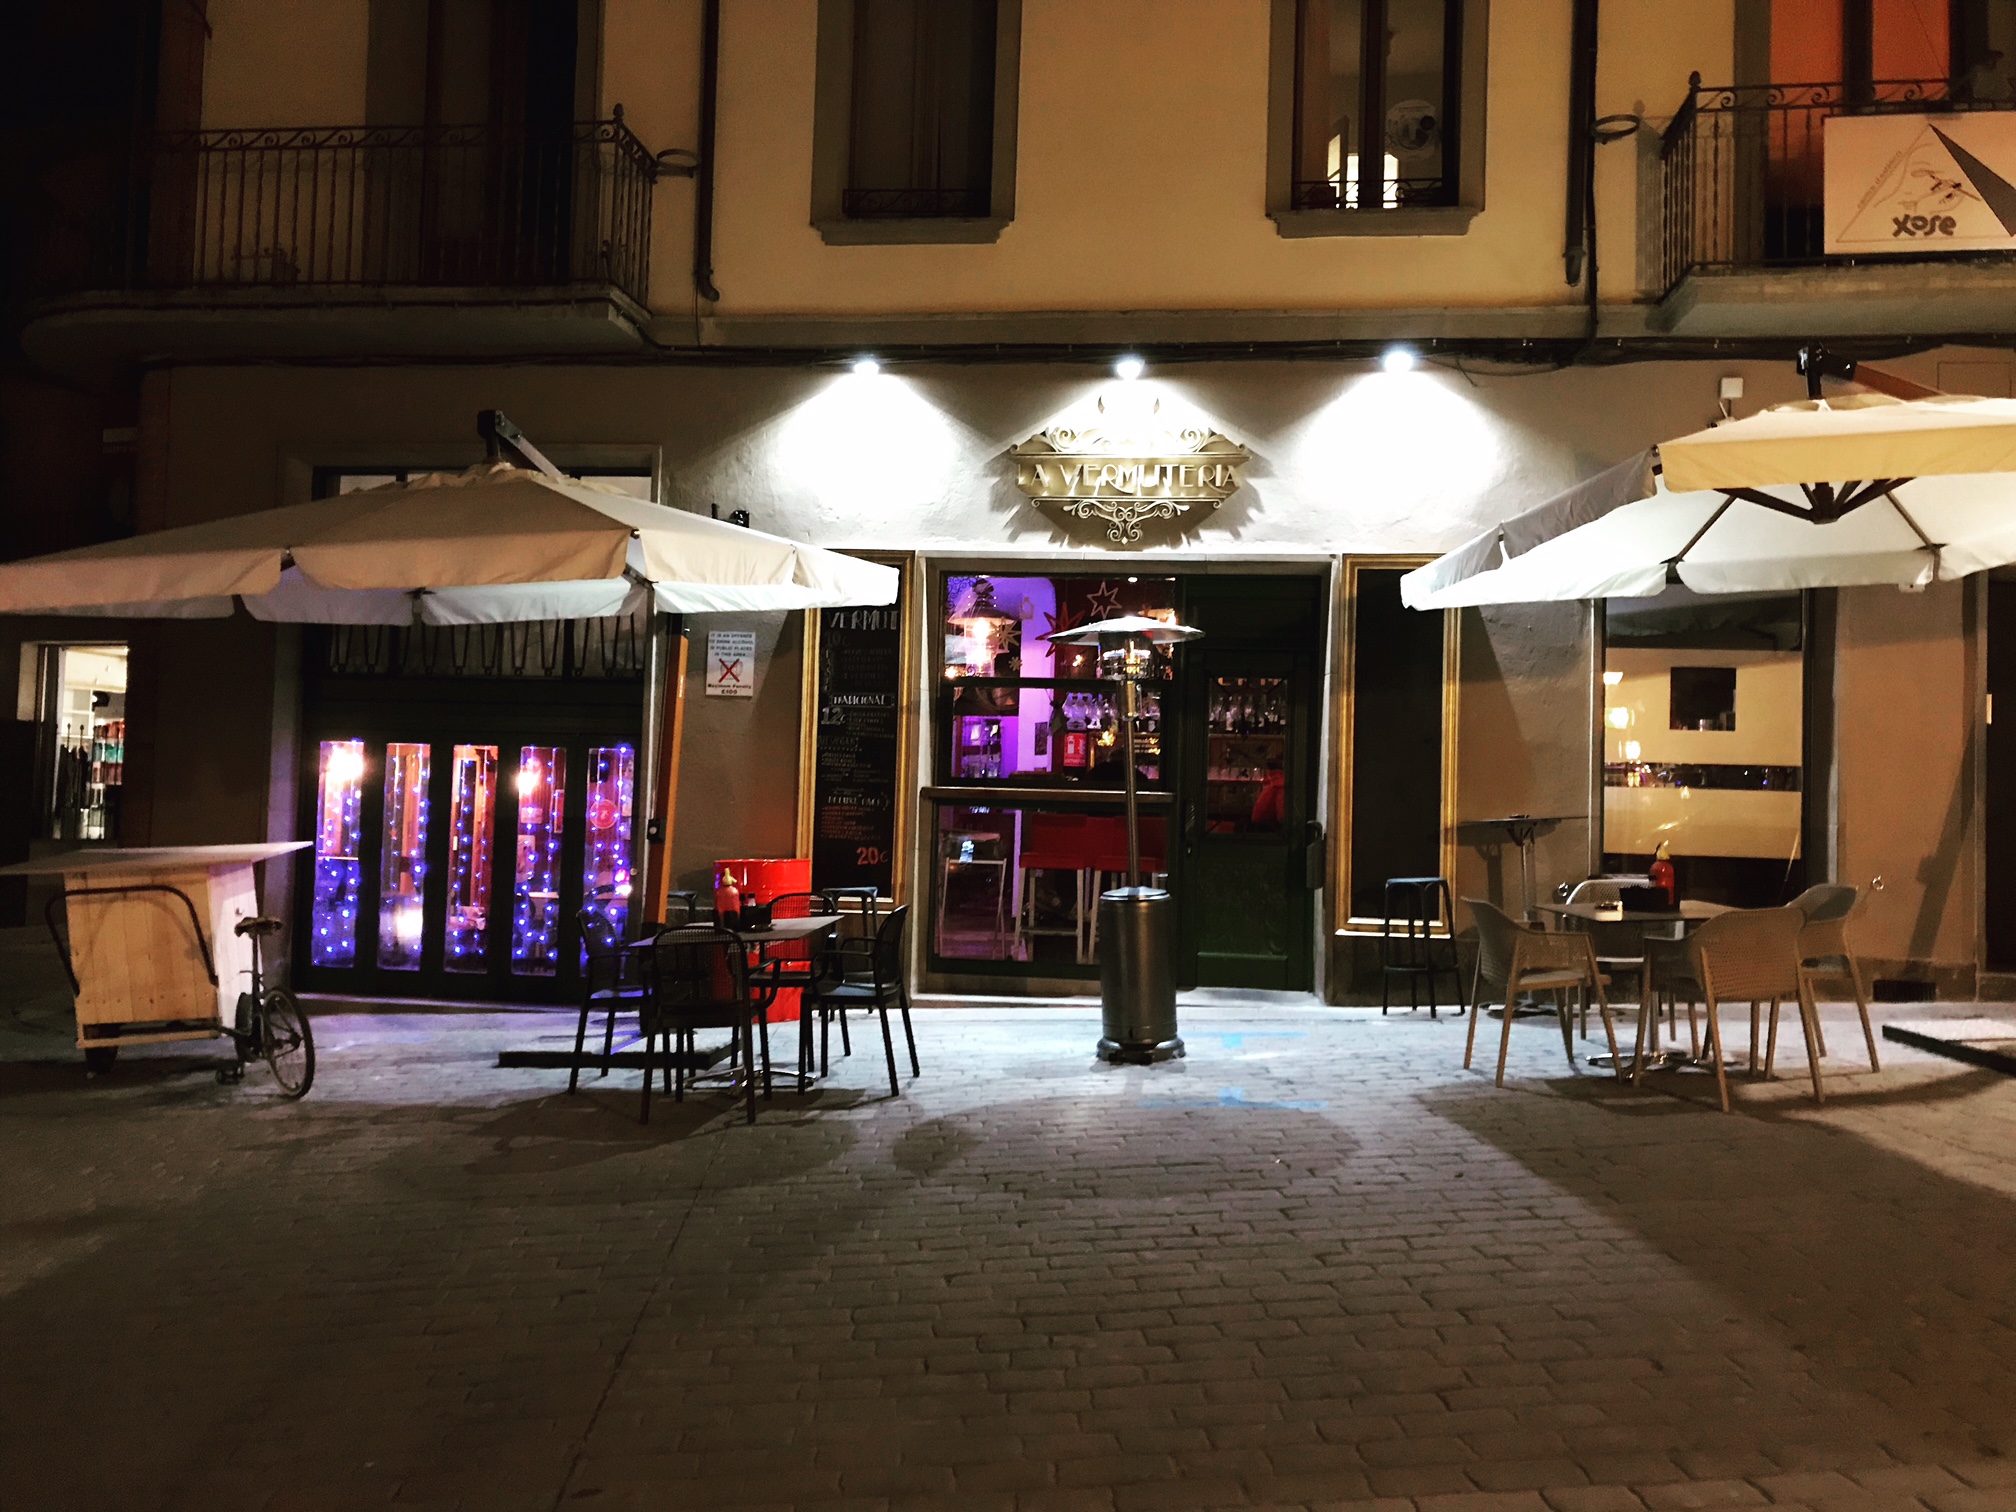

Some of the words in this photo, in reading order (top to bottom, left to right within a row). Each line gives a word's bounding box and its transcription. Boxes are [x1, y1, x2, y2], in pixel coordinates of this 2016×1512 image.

[1018, 463, 1048, 487] LA
[1059, 463, 1241, 494] VERMUTERIA
[826, 610, 898, 631] VERMUT
